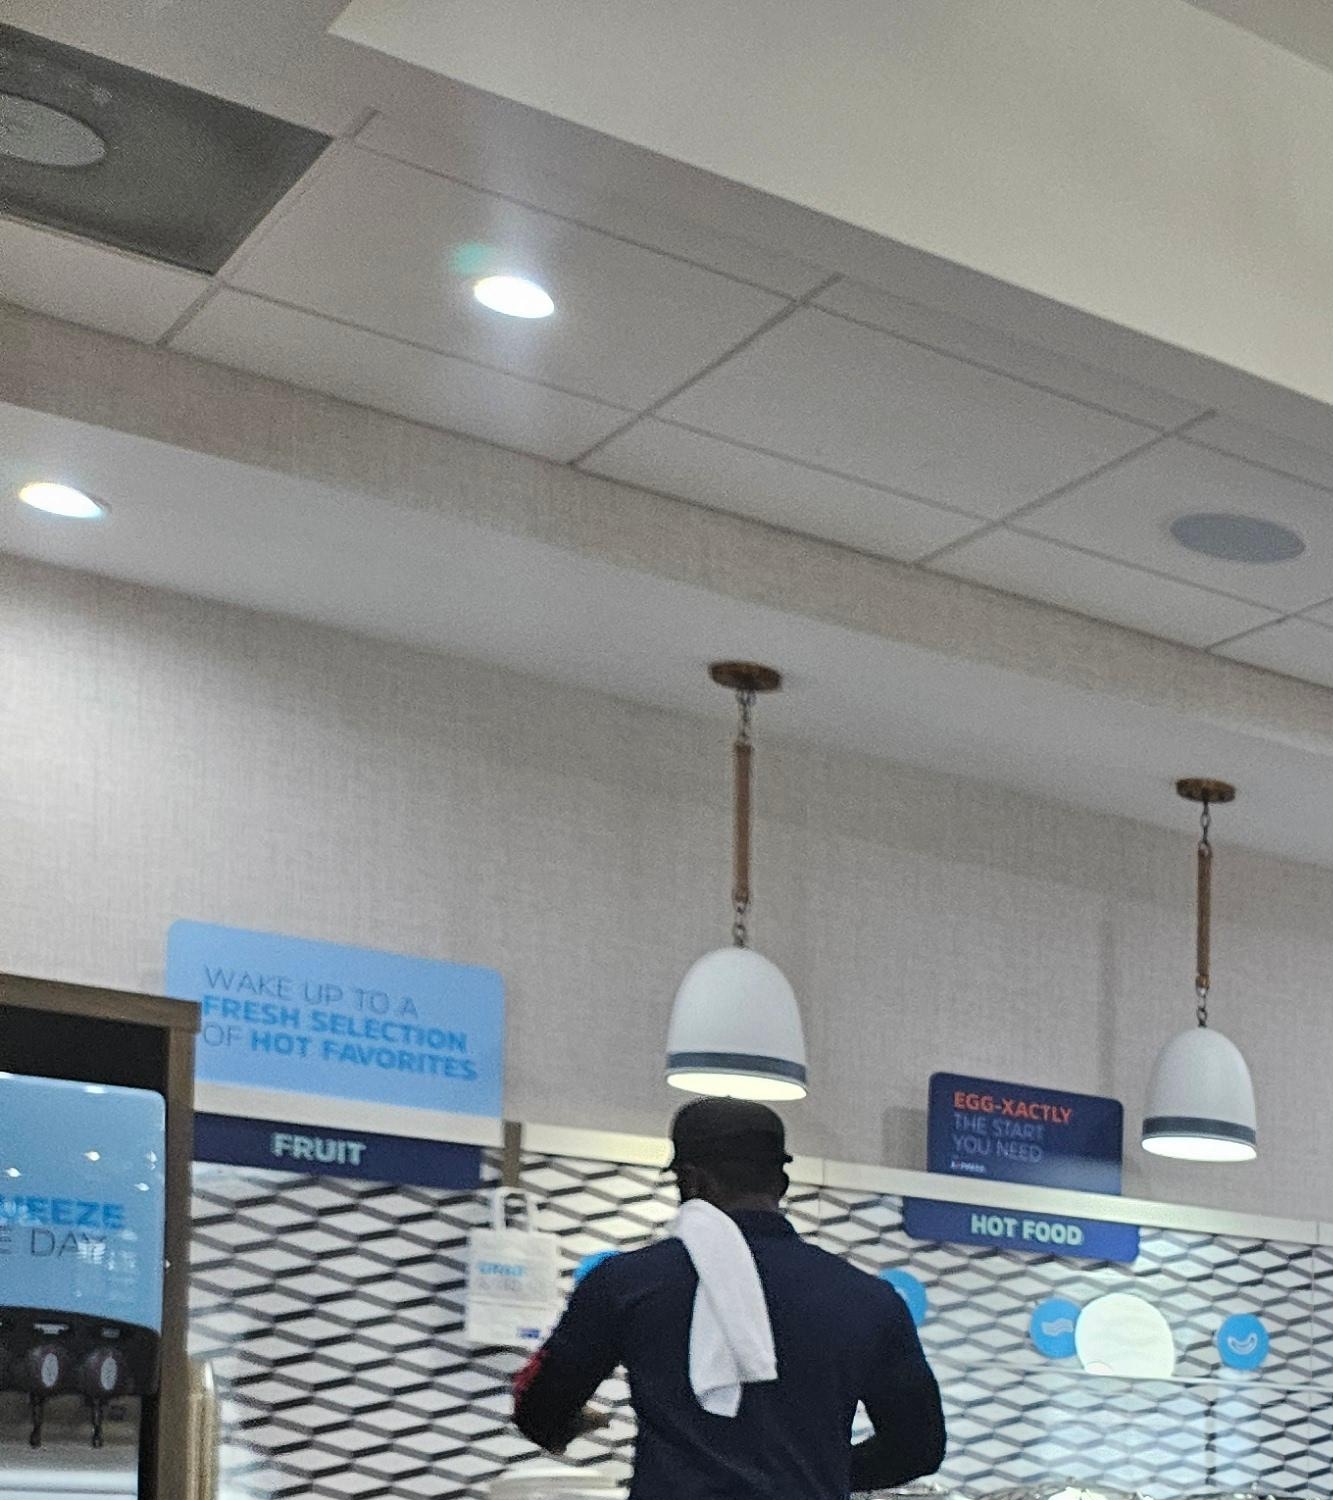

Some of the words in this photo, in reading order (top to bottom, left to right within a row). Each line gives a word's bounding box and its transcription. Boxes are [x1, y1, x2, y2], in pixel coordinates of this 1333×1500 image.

[204, 965, 292, 998] WAKE
[303, 980, 344, 1005] UP
[352, 988, 391, 1014] TO
[400, 996, 419, 1018] A
[203, 995, 300, 1029] FRESH
[310, 1009, 468, 1053] SELECTION
[202, 1022, 242, 1047] OF
[252, 1030, 312, 1058] HOT
[323, 1040, 478, 1081] FAVORITES
[953, 1091, 1073, 1124] EGG-XACTLY
[954, 1113, 988, 1135] THE
[993, 1119, 1045, 1140] START
[270, 1132, 368, 1166] FRUIT
[952, 1135, 991, 1154] YOU
[997, 1140, 1042, 1163] NEED
[971, 1213, 1018, 1238] HOT
[1022, 1219, 1085, 1245] FOOD
